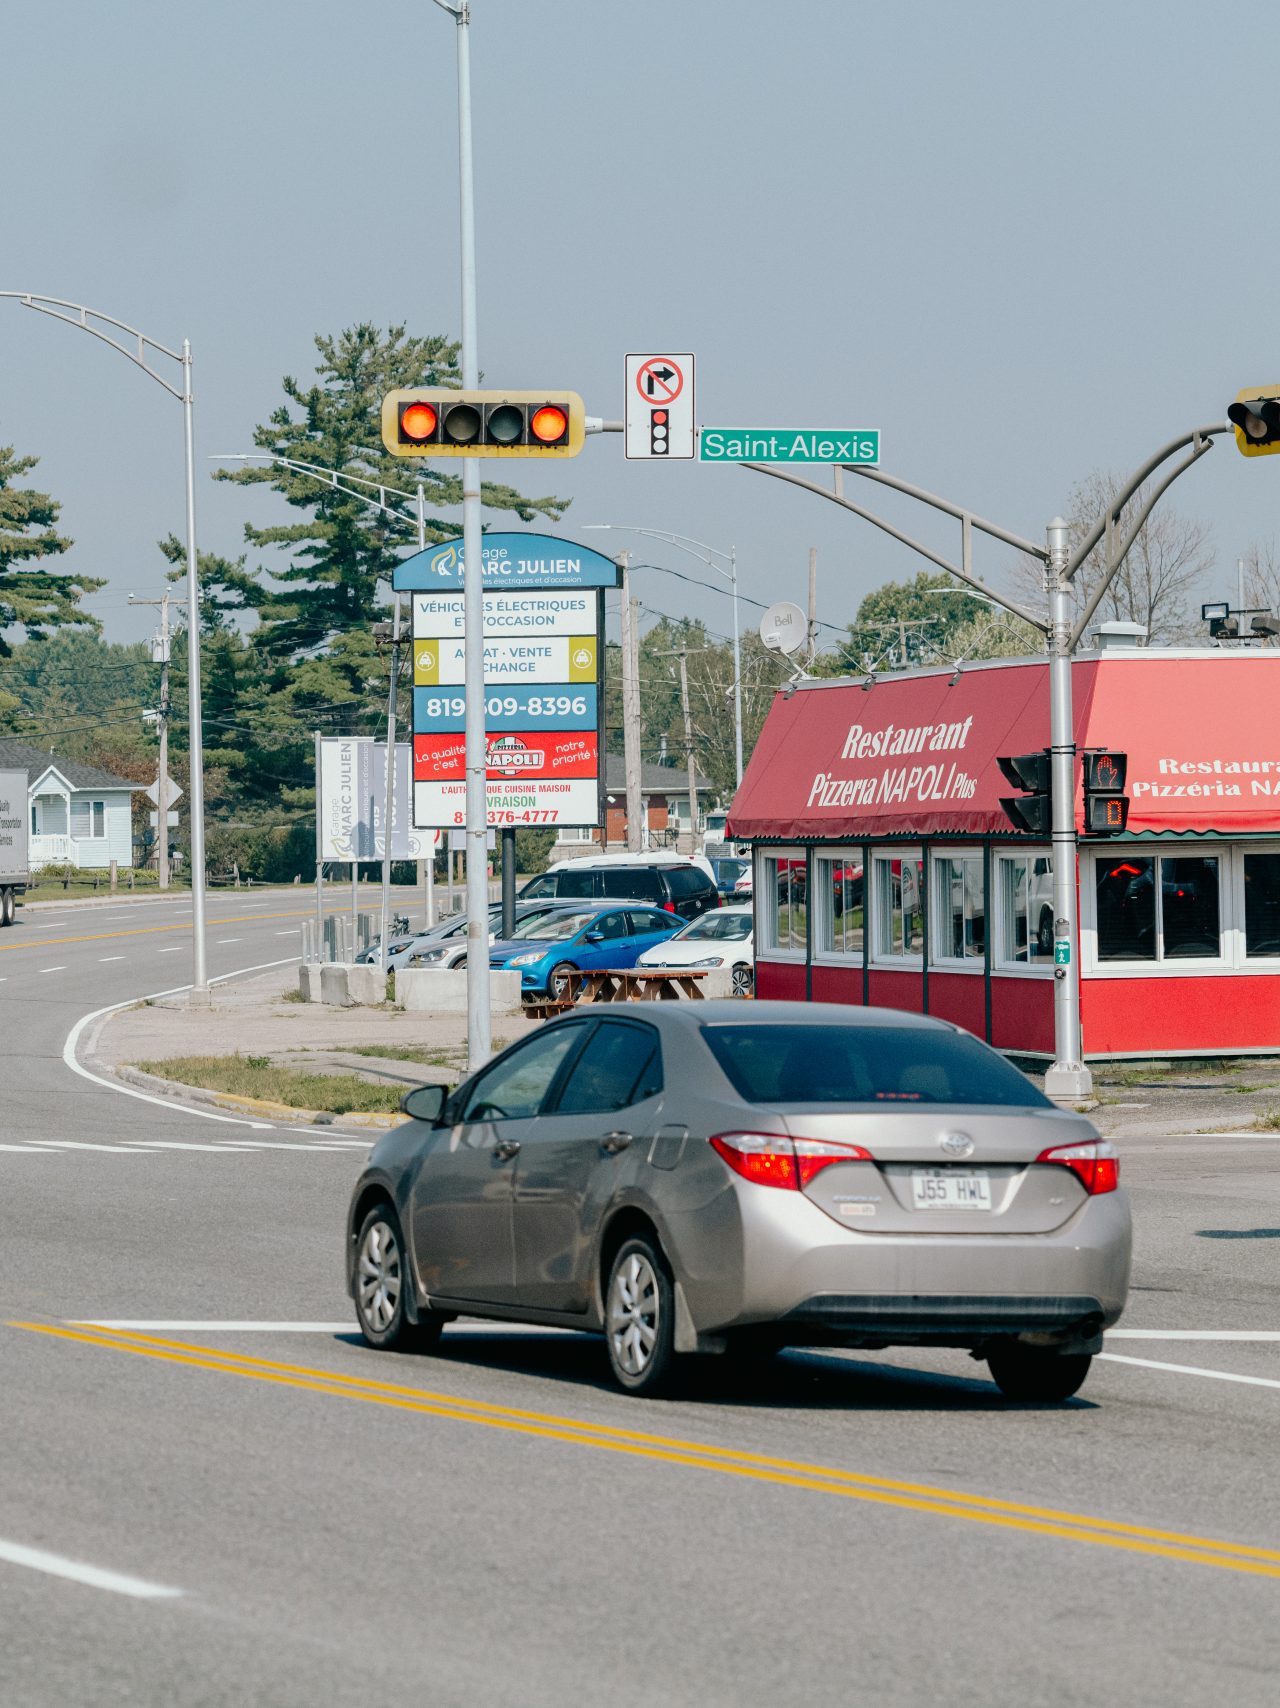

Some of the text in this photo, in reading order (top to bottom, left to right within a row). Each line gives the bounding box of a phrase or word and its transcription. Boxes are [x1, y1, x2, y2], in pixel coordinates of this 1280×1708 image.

[704, 433, 875, 459] Saint-Alexis
[517, 559, 581, 575] JULIEN
[496, 598, 586, 612] ÉLECTRIQUES
[482, 615, 555, 627] 'OCCASION
[774, 613, 793, 627] Bell
[454, 647, 552, 658] AAT VENTE
[483, 662, 536, 673] CHANGE
[426, 697, 587, 717] 819 09-8396
[841, 715, 973, 759] Restaurant
[415, 744, 466, 764] La qualité
[555, 741, 586, 754] notre
[433, 760, 459, 772] c'est
[552, 749, 591, 767] priorité
[341, 743, 352, 837] MARC JULIEN
[504, 784, 537, 794] CUISINE
[538, 783, 571, 793] MAISON
[875, 761, 957, 804] NAPOLI
[950, 772, 978, 799] Plus
[1132, 780, 1242, 798] Pizzéria
[486, 796, 536, 808] VRAISON
[330, 798, 340, 837] Garage
[487, 810, 559, 824] 376-4777
[917, 1179, 947, 1200] J55
